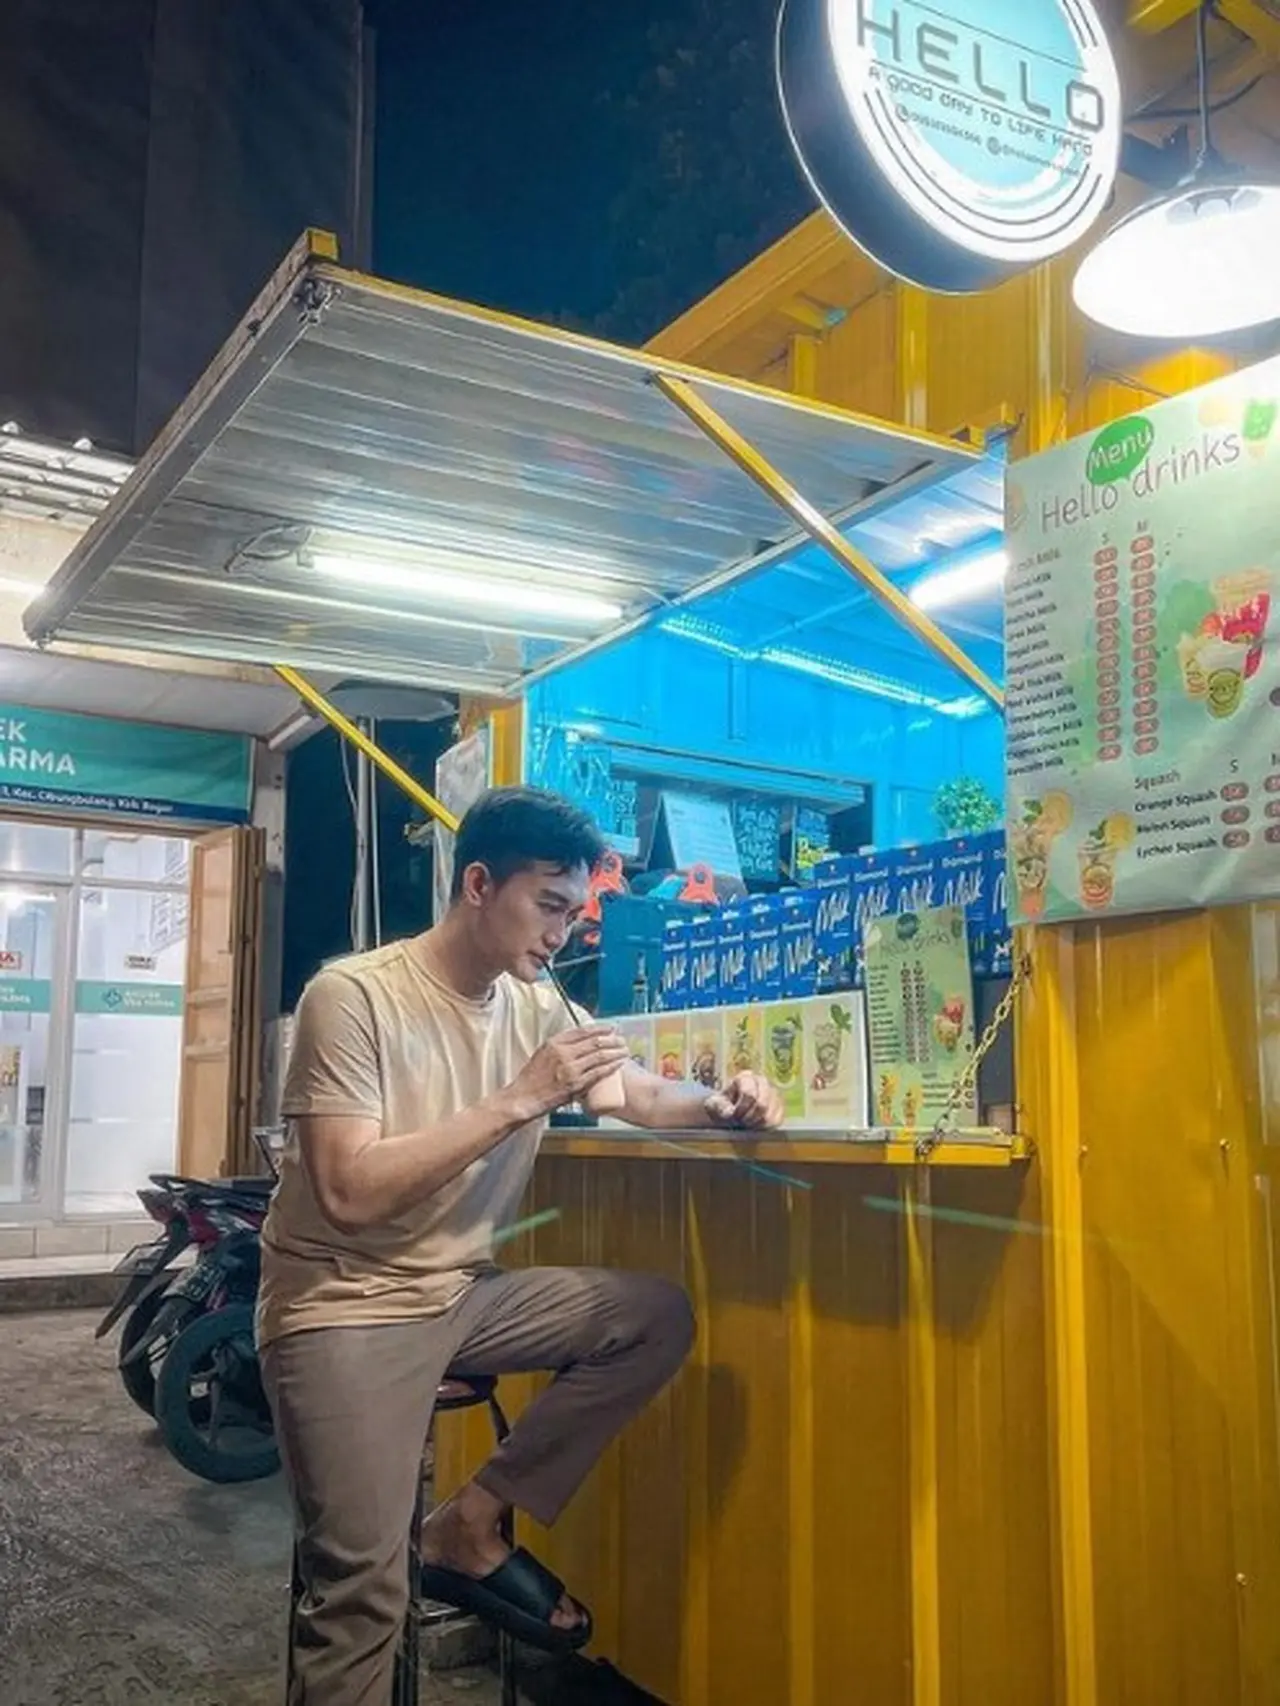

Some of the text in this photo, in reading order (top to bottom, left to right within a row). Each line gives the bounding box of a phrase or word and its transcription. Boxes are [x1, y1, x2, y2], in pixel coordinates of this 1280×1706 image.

[857, 0, 1104, 132] HELLO
[981, 107, 1002, 126] TO
[1089, 426, 1153, 471] Menu
[1041, 433, 1242, 533] Hello drinks
[1134, 758, 1239, 791] Squash S
[1135, 790, 1218, 812] Orange Squash
